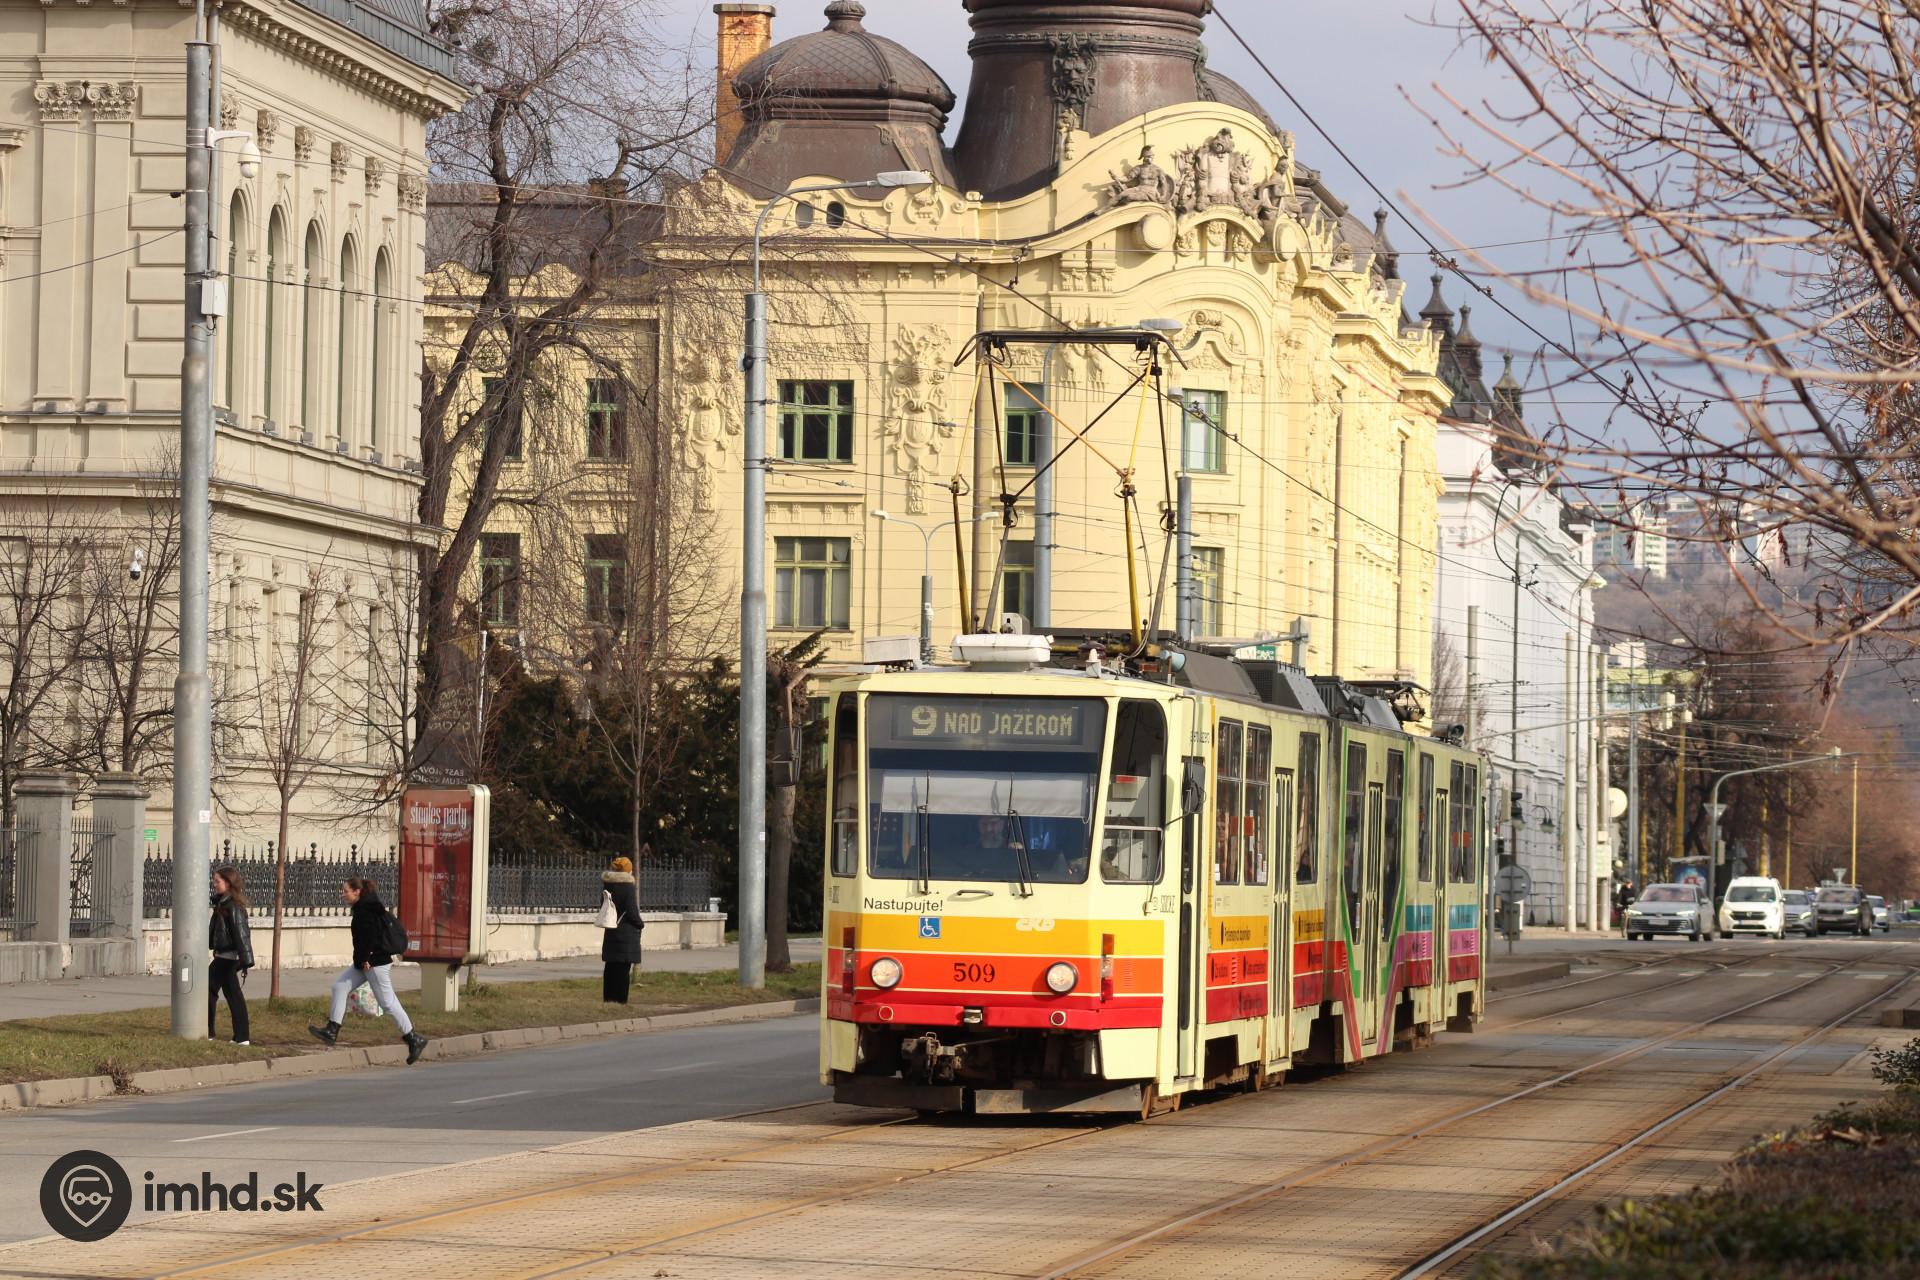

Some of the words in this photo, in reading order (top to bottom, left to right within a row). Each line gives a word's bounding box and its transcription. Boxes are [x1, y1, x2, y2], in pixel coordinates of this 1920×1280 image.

[911, 705, 938, 736] 9
[943, 711, 981, 735] NAD
[988, 711, 1073, 737] JAZEROM
[410, 801, 441, 828] singles
[443, 802, 467, 830] party
[863, 896, 944, 913] Nastupujte!
[953, 962, 996, 983] 509
